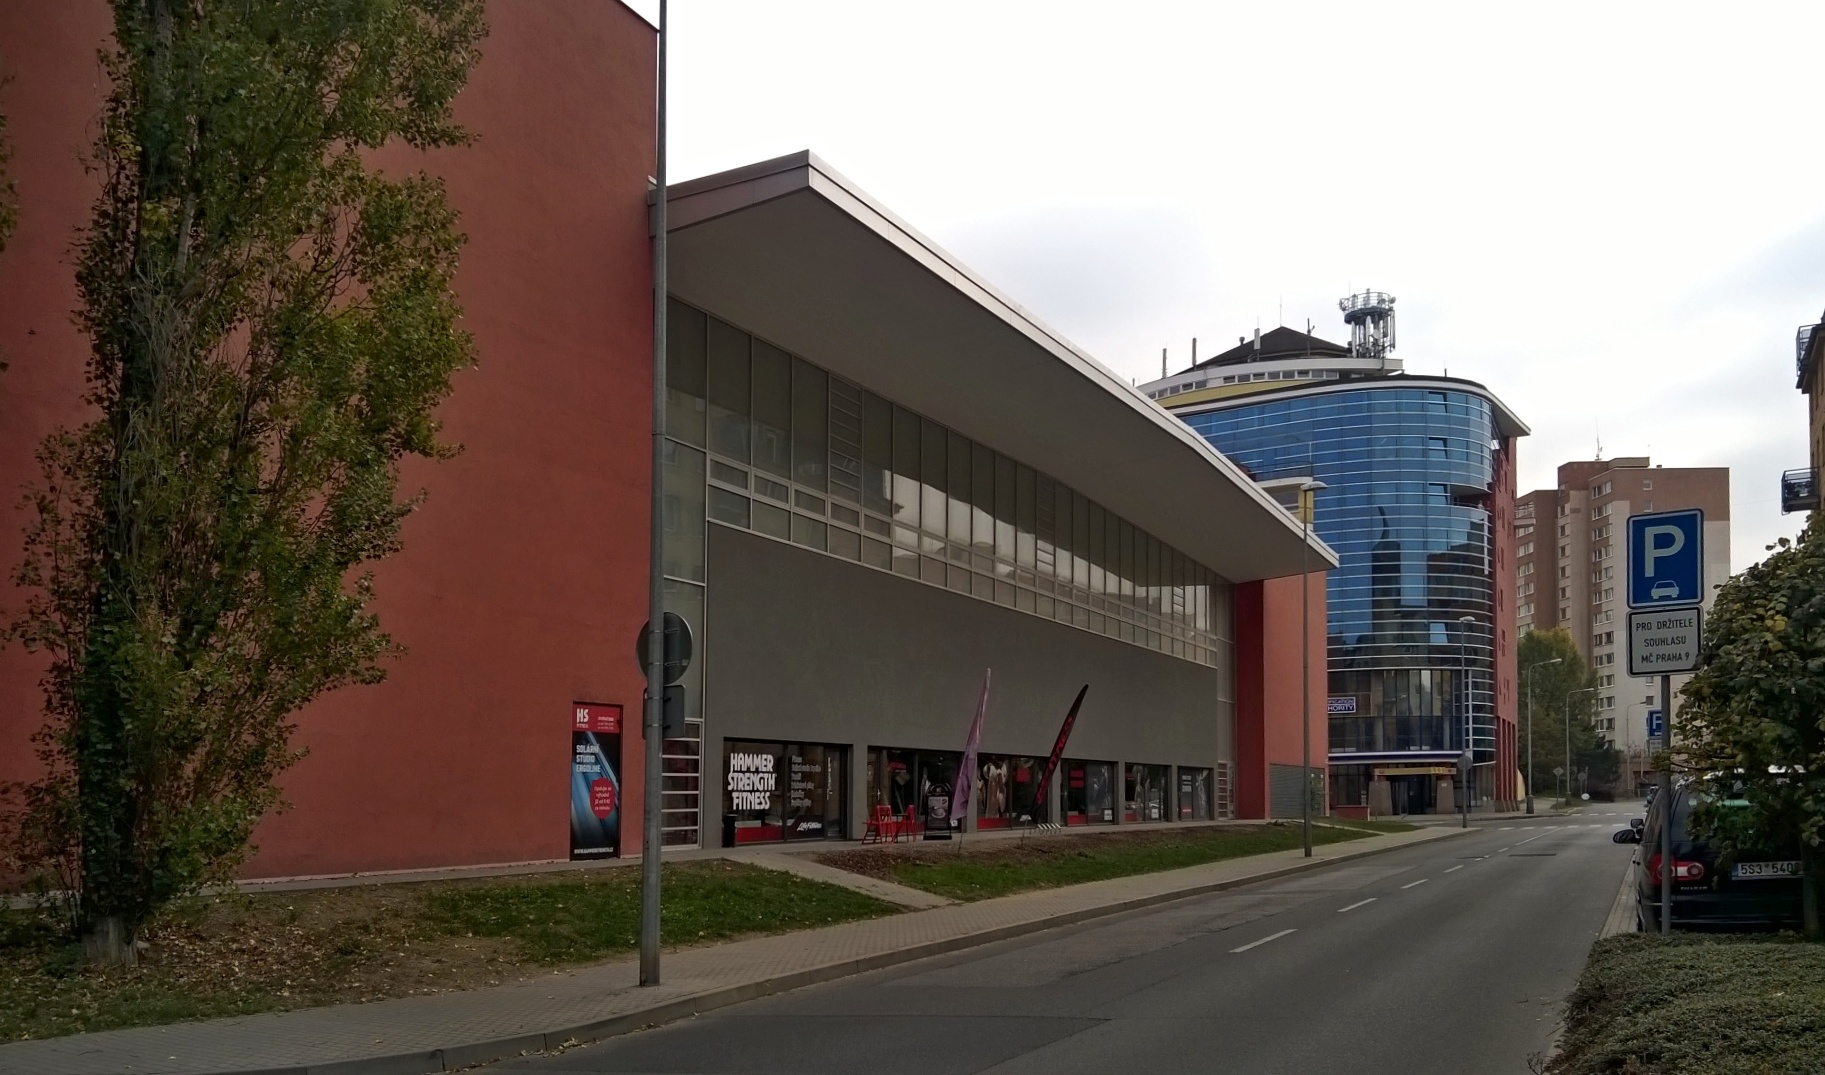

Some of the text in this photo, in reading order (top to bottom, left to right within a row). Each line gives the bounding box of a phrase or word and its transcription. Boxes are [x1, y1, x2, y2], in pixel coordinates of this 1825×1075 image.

[1644, 525, 1685, 578] P
[1636, 618, 1694, 631] PRO DRŽITELE
[1644, 635, 1687, 648] SOUHLASU
[1641, 652, 1690, 664] MČ PRAHA 9
[576, 708, 589, 723] HS
[576, 755, 595, 763] STUDIO
[730, 752, 774, 772] HAMMER
[576, 764, 601, 773] ERGOLINE
[728, 772, 775, 791] STRENGTH
[732, 791, 770, 810] FITNESS
[1741, 864, 1763, 875] 5S3
